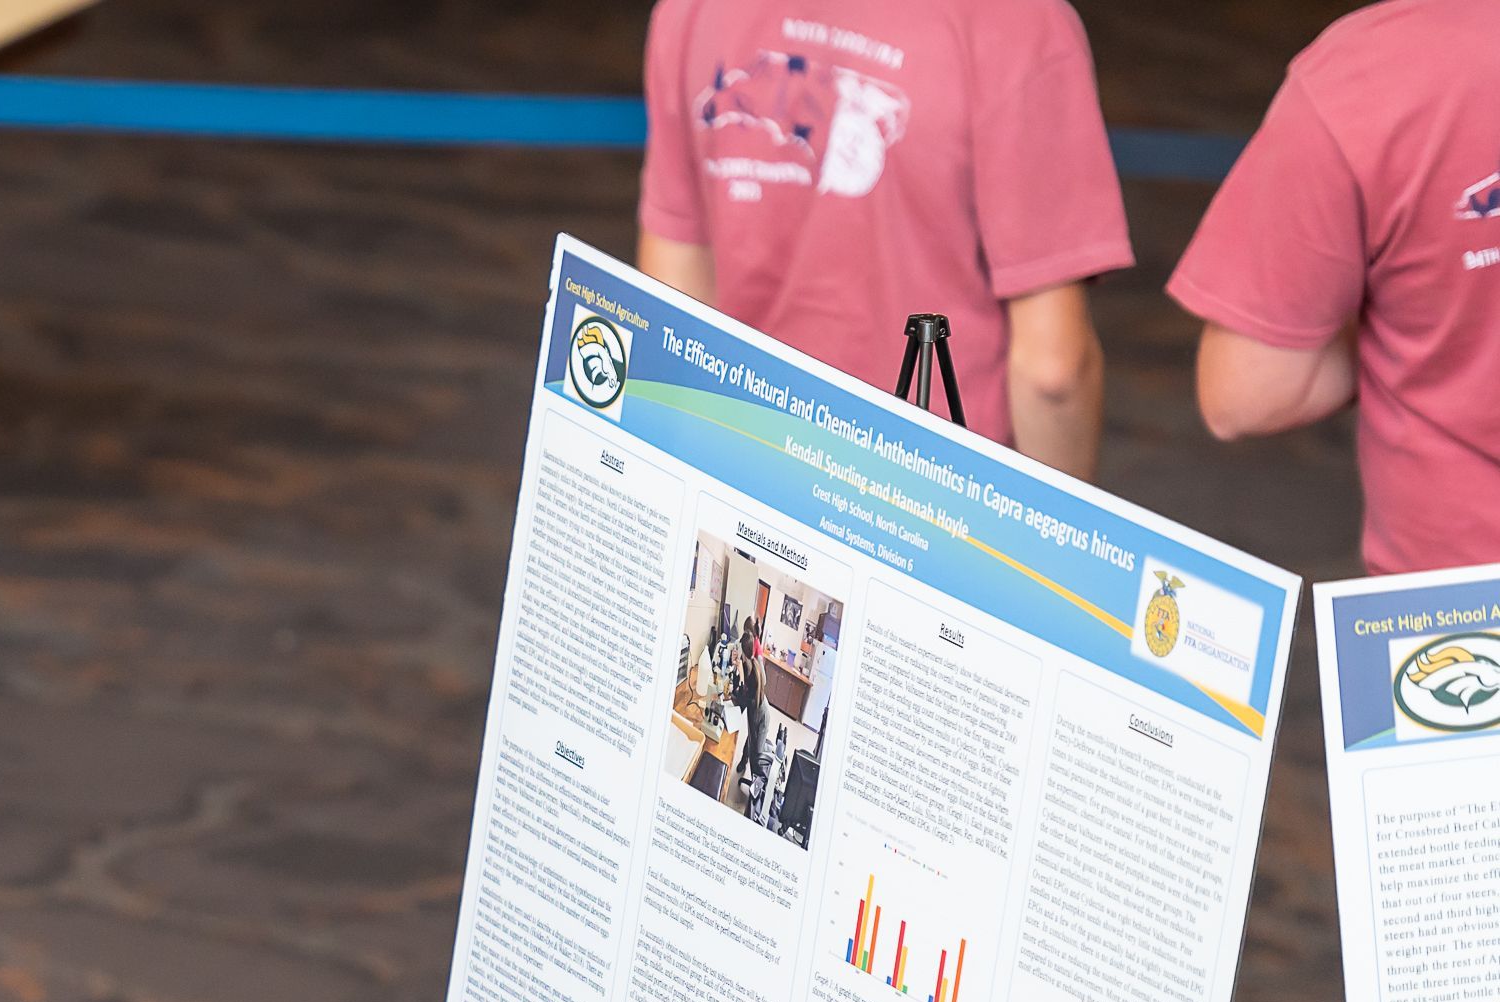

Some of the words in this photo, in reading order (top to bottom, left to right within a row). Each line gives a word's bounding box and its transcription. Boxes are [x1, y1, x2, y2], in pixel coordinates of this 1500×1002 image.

[564, 276, 581, 296] Crest
[580, 285, 595, 305] High
[594, 292, 616, 314] School
[614, 303, 649, 331] Agriculture
[600, 449, 625, 470] Abstract
[662, 325, 683, 356] The
[683, 338, 728, 383] Efficacy
[728, 363, 744, 386] of
[743, 368, 789, 409] Natural
[789, 396, 814, 424] and
[813, 404, 873, 449] Chemical
[872, 433, 964, 492] Anthelmintics
[966, 473, 981, 501] in
[982, 482, 1023, 520] Capra
[1024, 507, 1088, 550] aegagrus
[1090, 529, 1135, 571] hircus
[783, 434, 824, 470] Kendall
[823, 454, 868, 495] Spurling
[867, 480, 891, 502] and
[889, 486, 934, 523] Hannah
[934, 507, 969, 542] Hoyle
[812, 483, 831, 503] Crest
[830, 491, 848, 512] High
[847, 500, 874, 527] School,
[874, 513, 897, 536] North
[897, 524, 929, 551] Carolina
[737, 520, 766, 545] Materials
[766, 538, 779, 552] and
[779, 543, 808, 567] Methods
[818, 515, 845, 538] Animal
[844, 527, 876, 556] Systems,
[876, 543, 907, 569] Division
[906, 557, 914, 572] 6
[939, 622, 964, 644] Results
[1354, 617, 1394, 635] Crest
[1397, 611, 1432, 632] High
[1435, 604, 1486, 627] School
[1198, 640, 1250, 673] ORGANIZATION
[1128, 713, 1173, 743] Conclusions
[555, 739, 585, 765] Objectives
